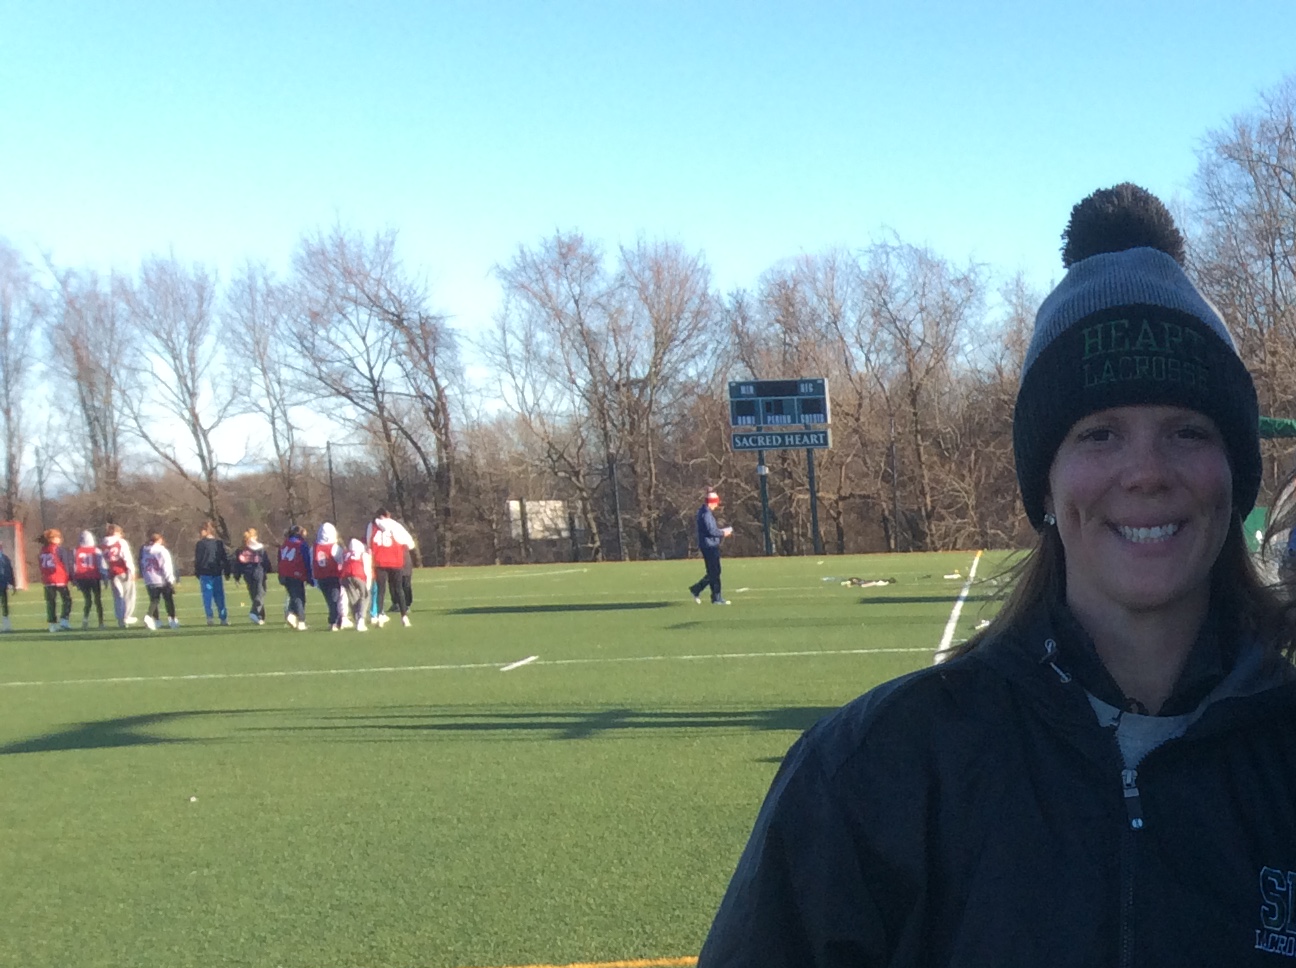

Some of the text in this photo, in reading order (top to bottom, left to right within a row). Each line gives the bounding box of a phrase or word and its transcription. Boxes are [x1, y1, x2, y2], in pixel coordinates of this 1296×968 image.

[1081, 318, 1205, 360] HEART
[735, 432, 826, 448] SACRED HEART
